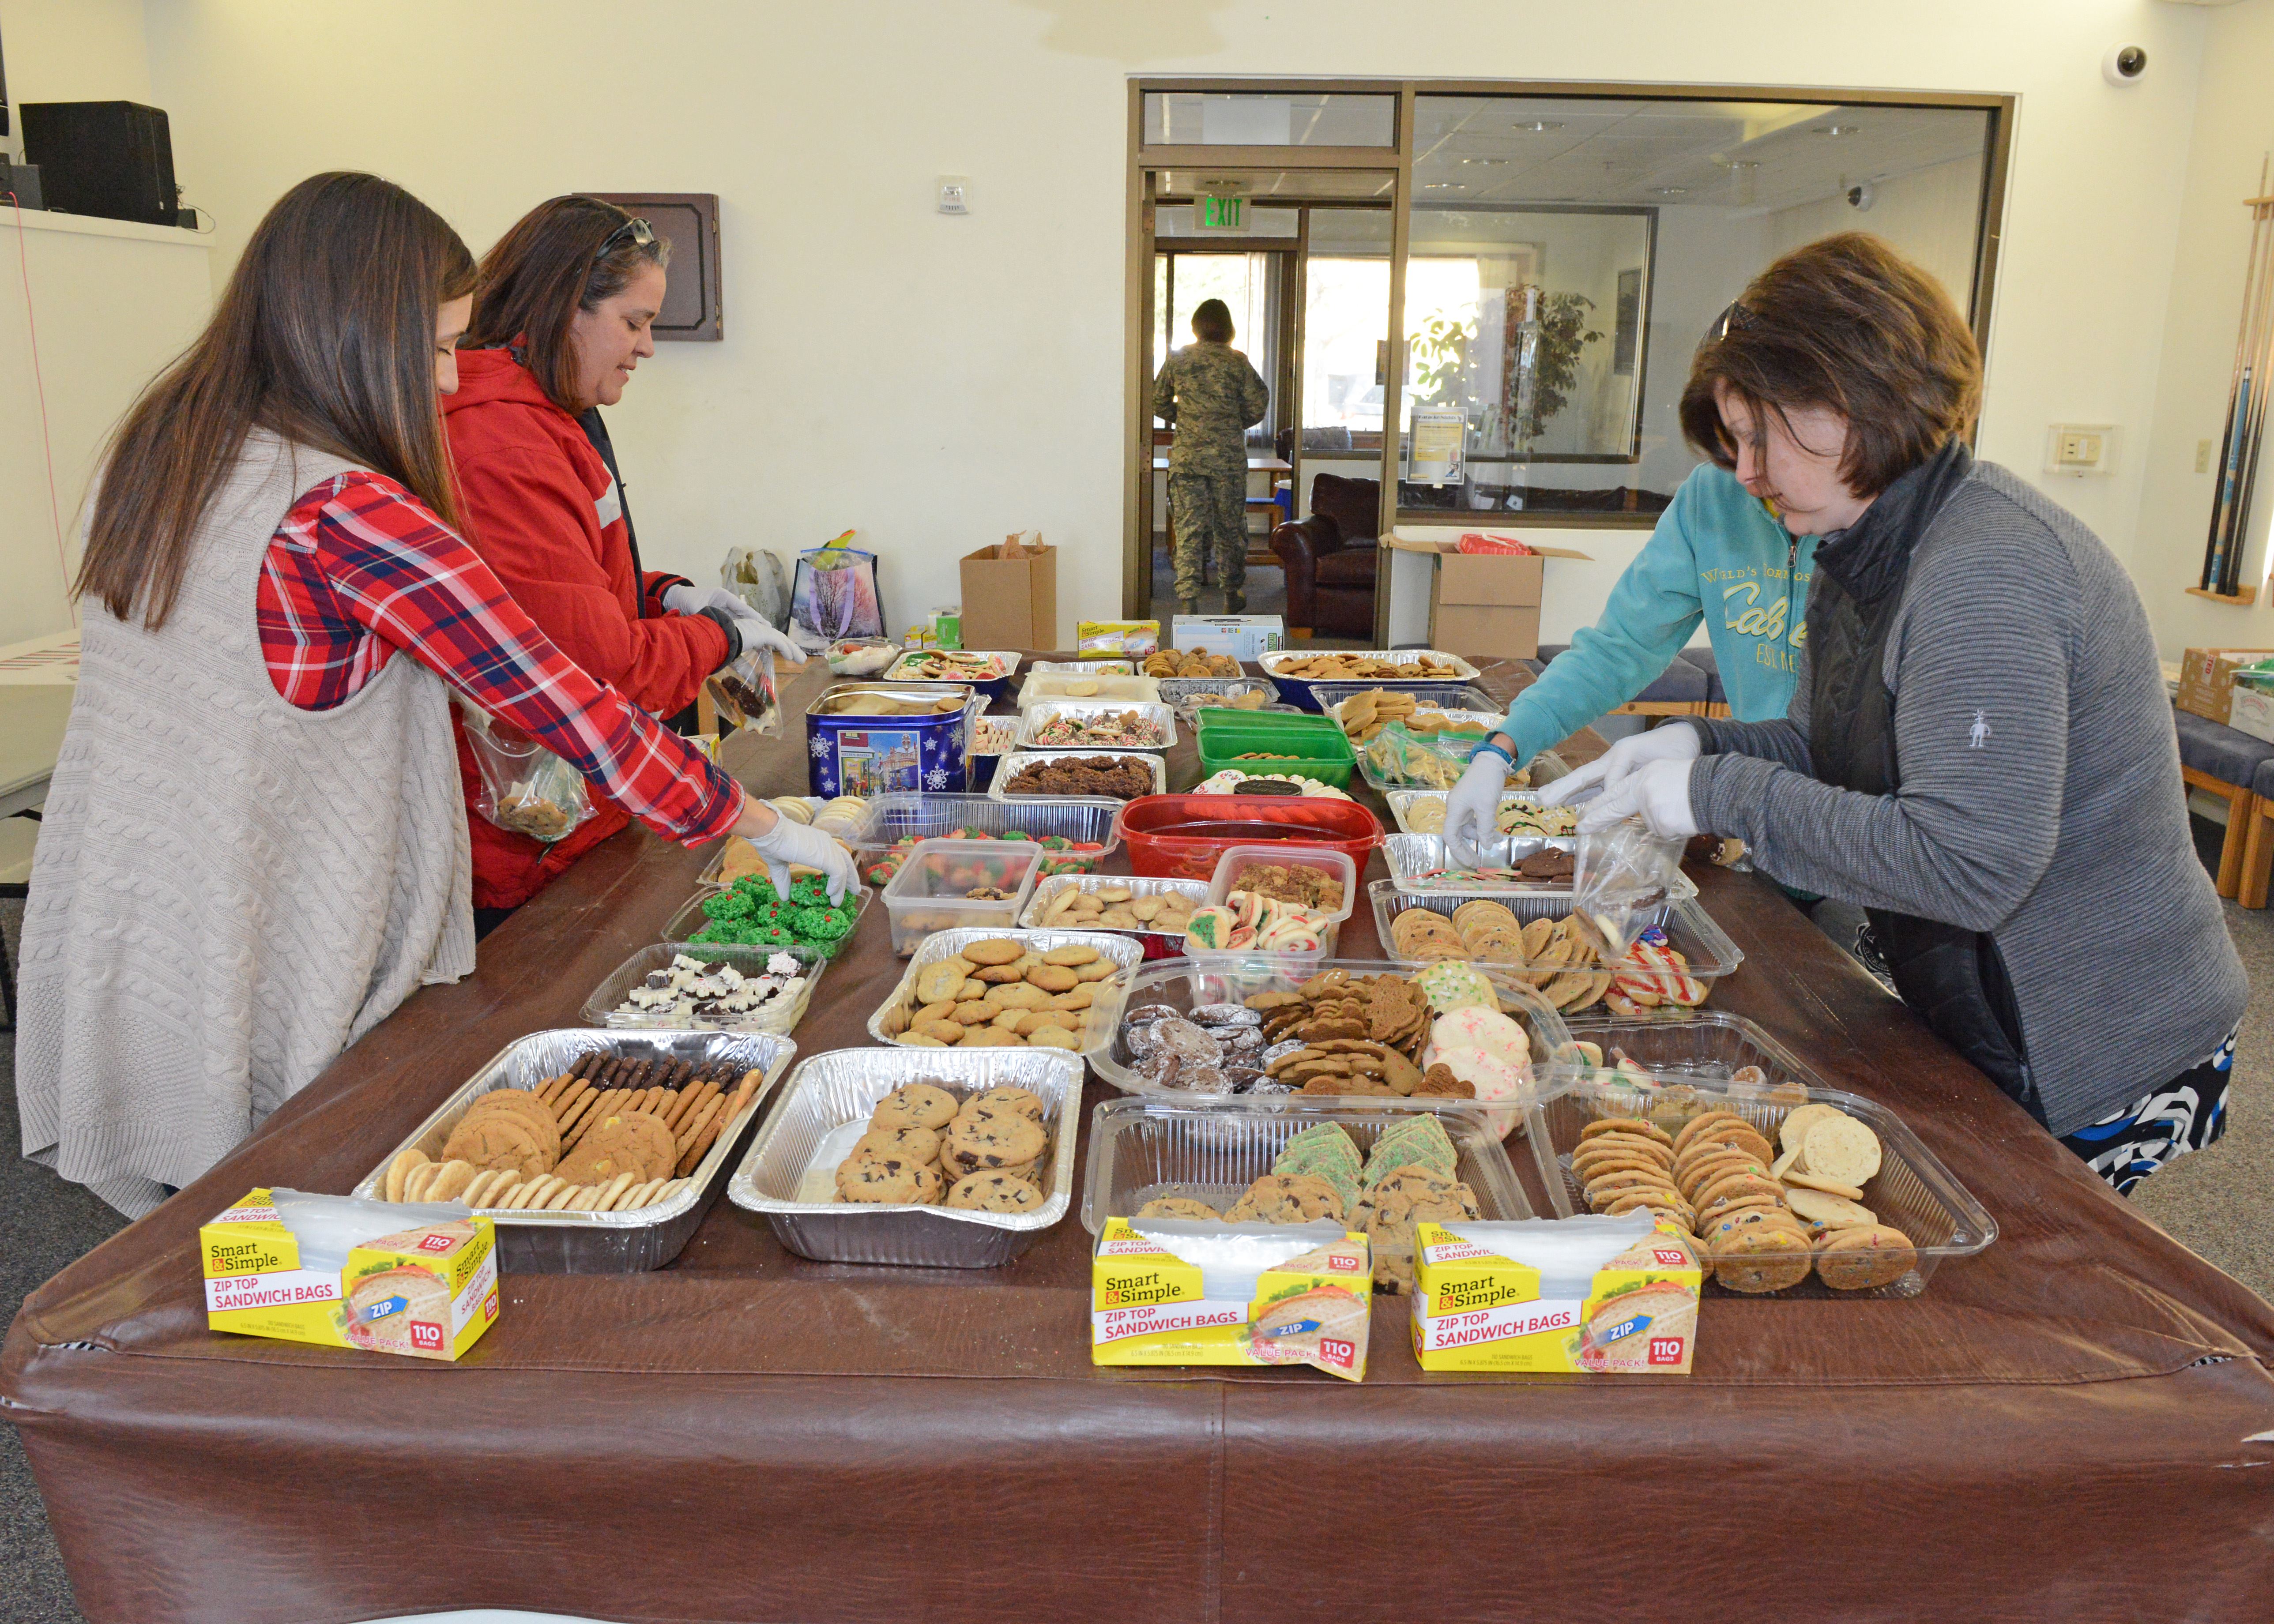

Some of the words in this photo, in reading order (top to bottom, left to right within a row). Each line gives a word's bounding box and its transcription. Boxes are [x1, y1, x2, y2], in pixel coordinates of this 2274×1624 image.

[1205, 198, 1242, 226] EXIT
[1700, 566, 1757, 583] WRLD'S
[426, 1237, 450, 1247] 110
[211, 1243, 257, 1258] Smart
[1657, 1252, 1681, 1260] 110
[456, 1241, 480, 1277] Smart
[1332, 1257, 1356, 1266] 110
[476, 1266, 485, 1278] TOP
[214, 1281, 232, 1292] ZIP
[235, 1278, 258, 1290] TOP
[1106, 1272, 1160, 1291] Smart
[1440, 1276, 1495, 1296] Smart
[215, 1288, 291, 1308] SANDWICH
[295, 1284, 333, 1300] BAGS
[462, 1267, 491, 1315] SANDWICH
[472, 1290, 484, 1312] BAGS
[486, 1294, 497, 1313] 110
[371, 1301, 393, 1319] ZIP
[1105, 1312, 1126, 1323] ZIP
[1129, 1308, 1156, 1319] TOP
[1105, 1316, 1191, 1339] SANDWICH
[1196, 1312, 1238, 1326] BAGS
[1279, 1323, 1303, 1335] ZIP
[1436, 1320, 1524, 1347] SANDWICH
[1529, 1312, 1571, 1331] BAGS
[1437, 1318, 1459, 1331] ZIP
[1462, 1312, 1489, 1327] TOP
[413, 1325, 440, 1341] 110
[1611, 1322, 1634, 1340] ZIP
[343, 1333, 376, 1345] VALUE
[379, 1338, 409, 1349] PACK!
[1323, 1341, 1351, 1357] 110
[1653, 1341, 1680, 1355] 110
[1245, 1348, 1281, 1357] VALUE
[1285, 1350, 1316, 1360] PACK!
[1327, 1354, 1345, 1363] BAGS
